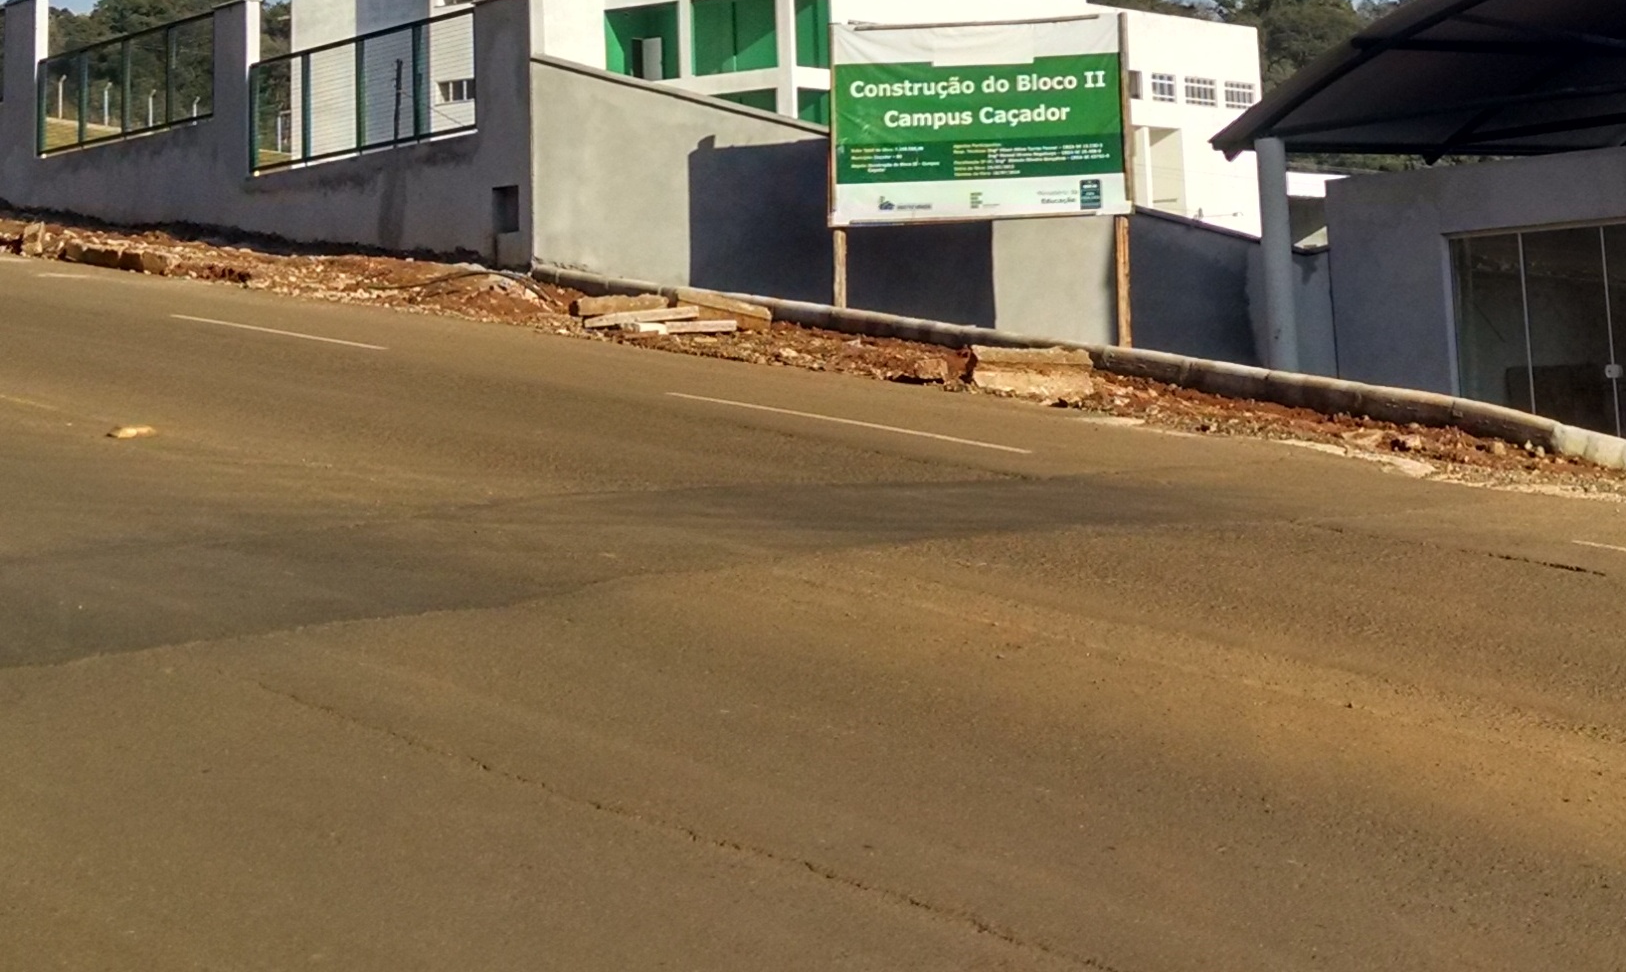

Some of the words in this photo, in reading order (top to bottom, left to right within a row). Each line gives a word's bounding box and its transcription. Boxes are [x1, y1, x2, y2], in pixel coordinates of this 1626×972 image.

[850, 76, 975, 99] Construção
[981, 75, 1010, 94] do
[1016, 73, 1078, 92] Bloco
[1083, 70, 1106, 88] II
[884, 110, 973, 130] Campus
[979, 104, 1071, 126] Caçador
